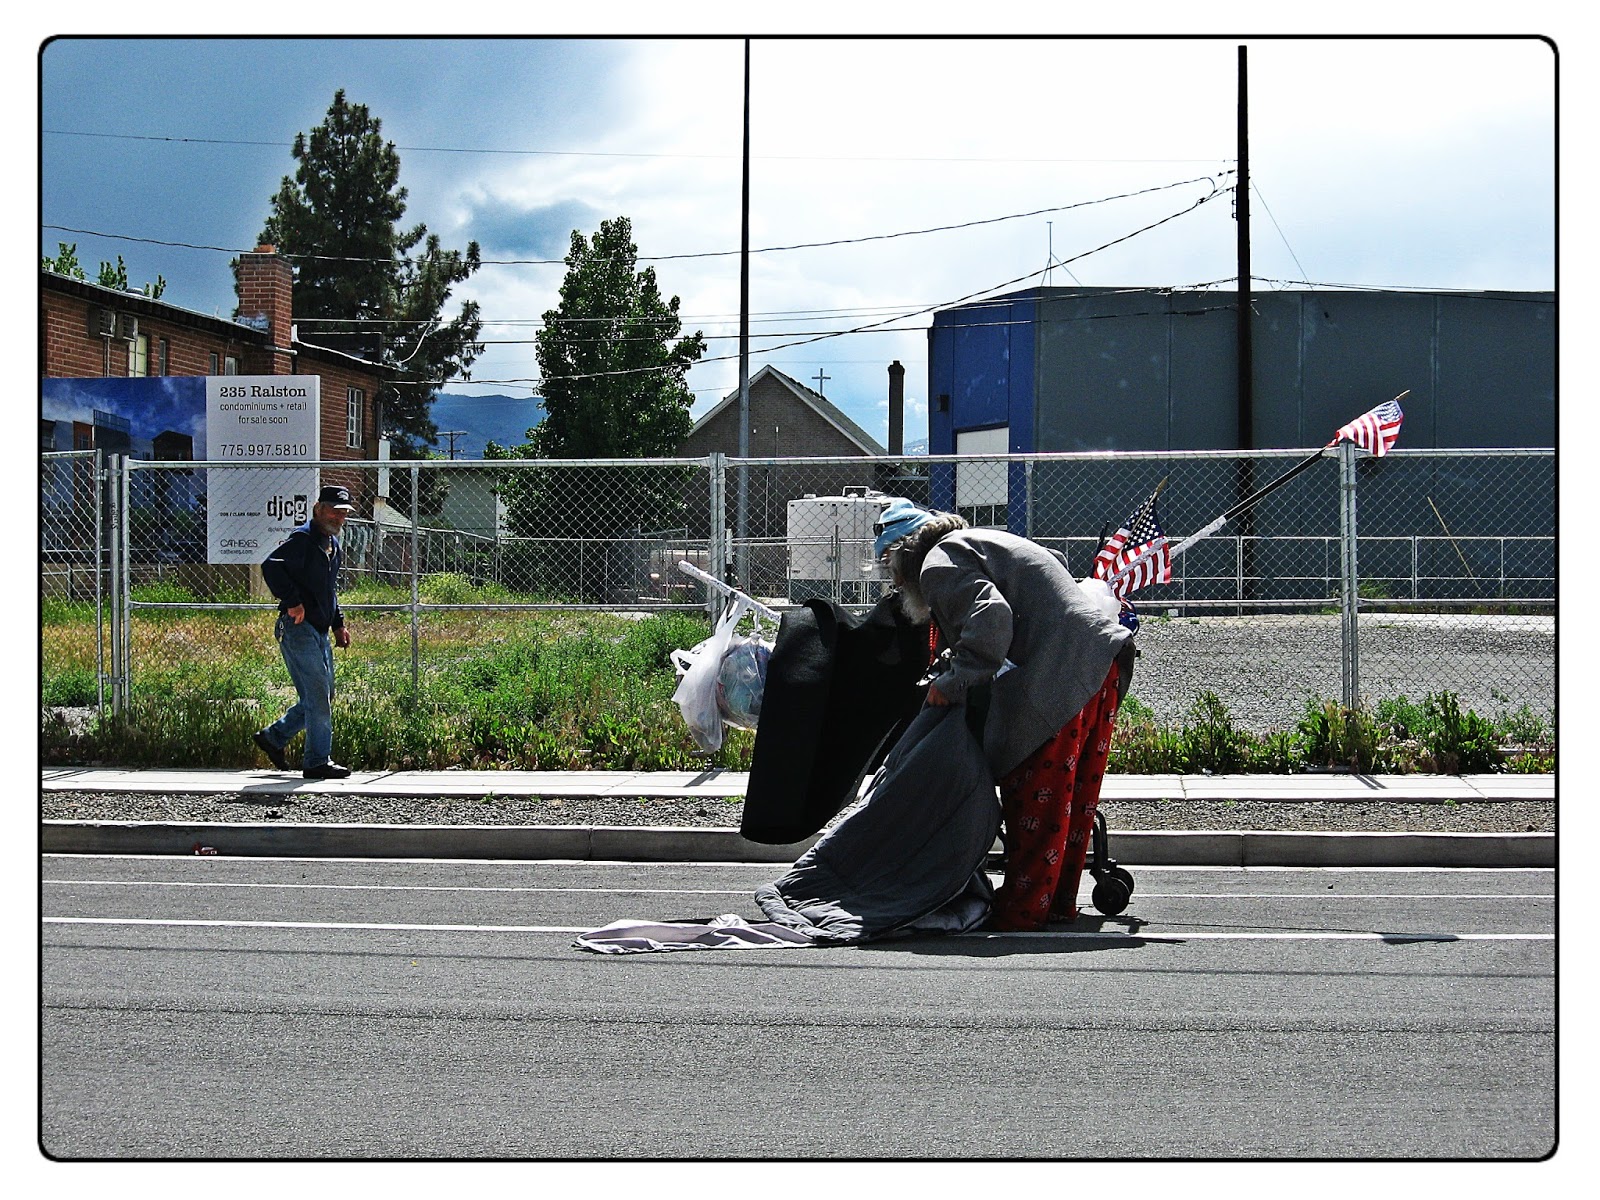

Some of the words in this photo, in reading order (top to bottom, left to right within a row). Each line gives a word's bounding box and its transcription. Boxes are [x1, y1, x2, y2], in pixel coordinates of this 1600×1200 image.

[220, 386, 247, 398] 235
[250, 385, 307, 398] Ralston
[220, 402, 278, 411] condominiums
[286, 402, 307, 411] retail
[238, 415, 250, 424] for
[250, 415, 267, 424] sale
[268, 416, 288, 424] soon
[220, 444, 307, 456] 775.997.5810
[266, 494, 308, 524] djcg
[220, 539, 258, 548] CATHEXES
